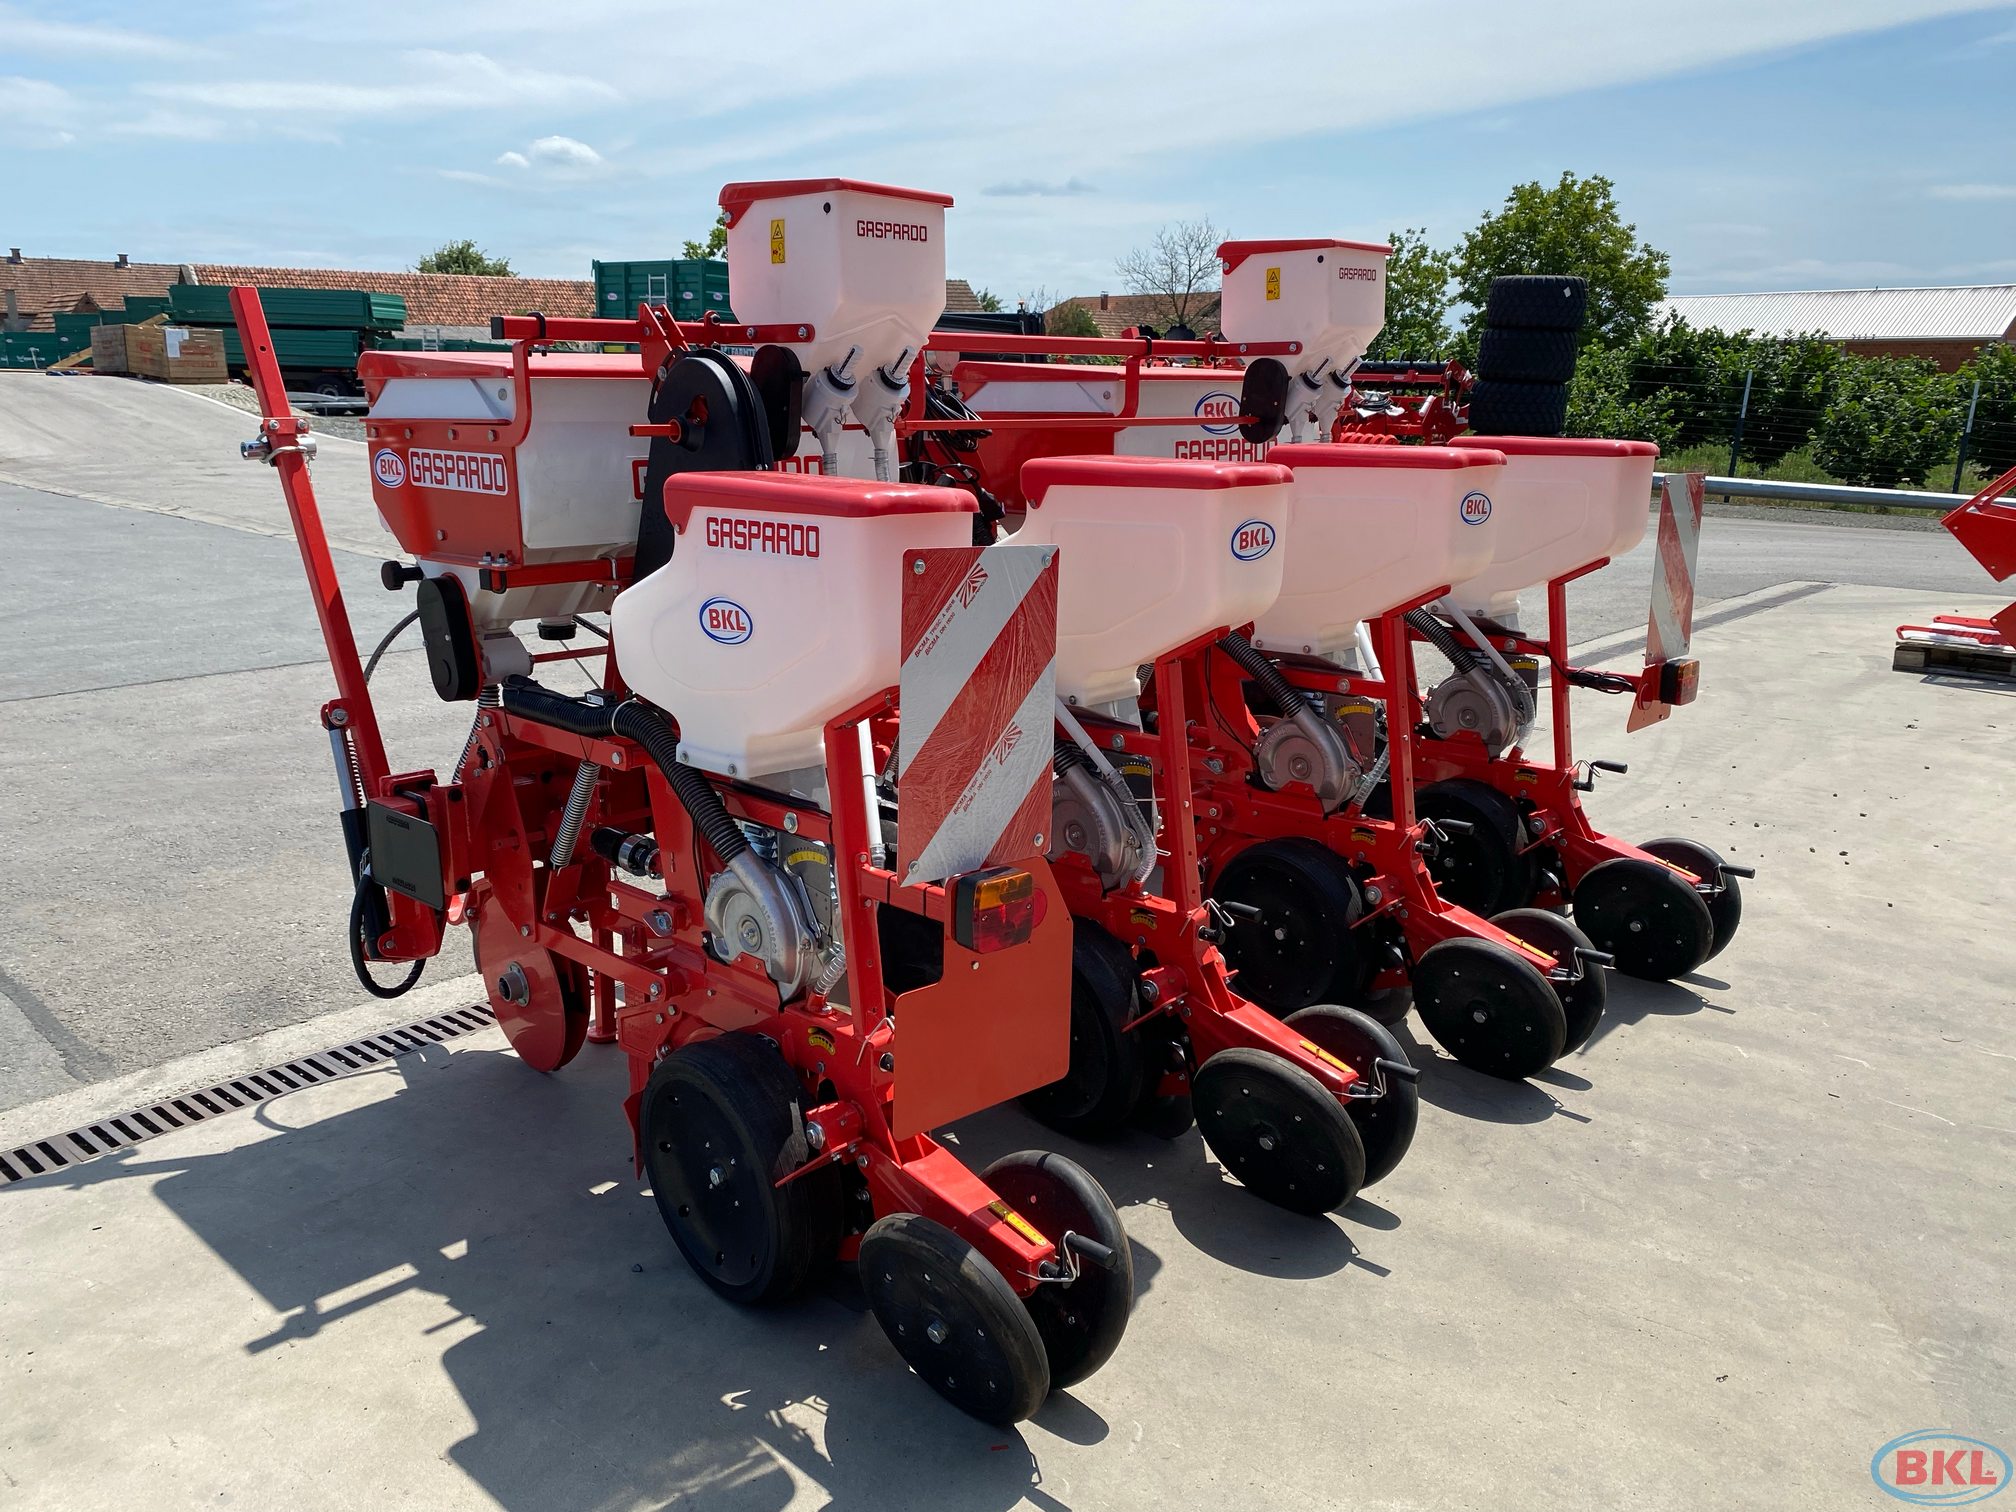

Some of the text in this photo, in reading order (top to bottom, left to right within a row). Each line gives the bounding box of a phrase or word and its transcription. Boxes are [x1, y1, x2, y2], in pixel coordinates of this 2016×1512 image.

[856, 219, 928, 242] GASPARDO
[1338, 267, 1377, 282] GASPARDO
[1175, 438, 1278, 463] GASPARD
[380, 458, 402, 476] BKL
[410, 451, 506, 492] GASPARDO
[1466, 499, 1488, 515] BKL
[706, 516, 820, 558] GASPARDO
[1239, 527, 1270, 551] BKL
[708, 608, 747, 632] BKL
